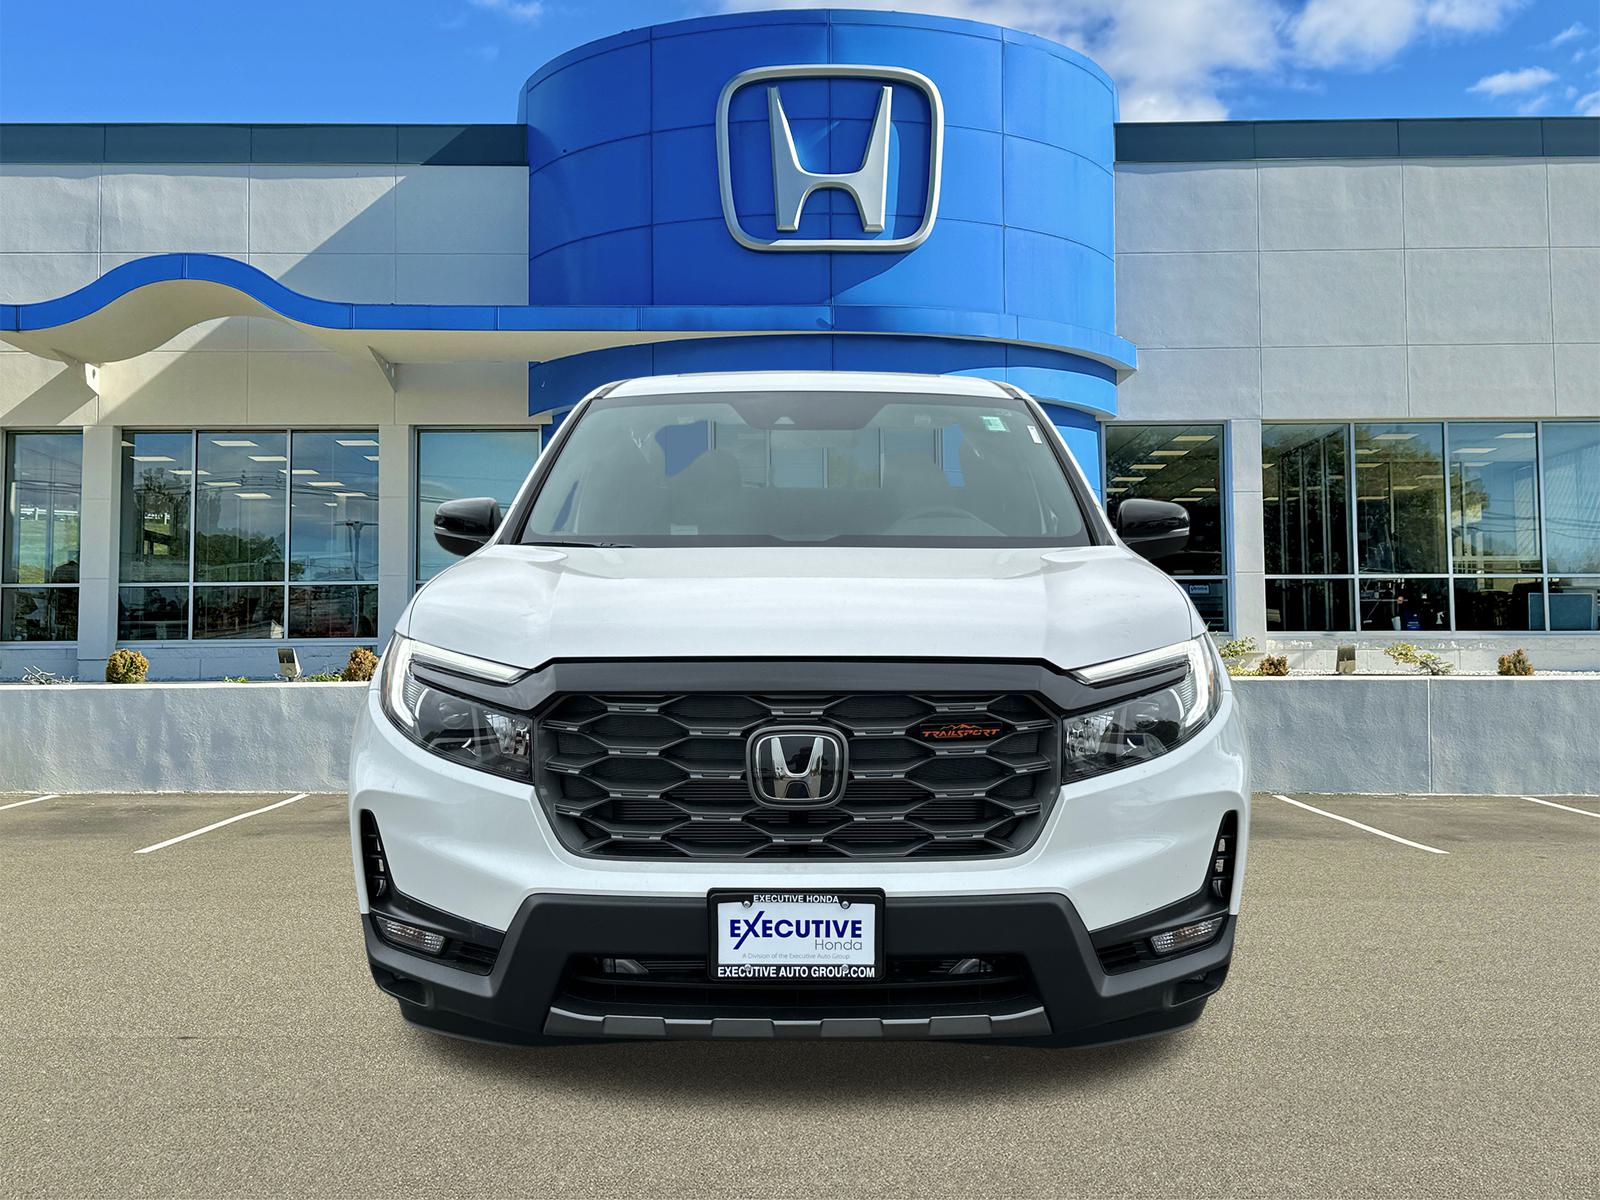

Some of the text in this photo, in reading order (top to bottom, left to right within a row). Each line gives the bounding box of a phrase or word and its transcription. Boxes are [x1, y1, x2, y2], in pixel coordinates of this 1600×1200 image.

[922, 728, 1000, 738] TRAILSPORT
[753, 895, 839, 904] EXECUTIVE HONDA
[729, 911, 862, 950] EXECUTIVE
[814, 939, 863, 951] Honda
[717, 966, 777, 977] EXECUTIVE
[779, 967, 808, 977] AUTO
